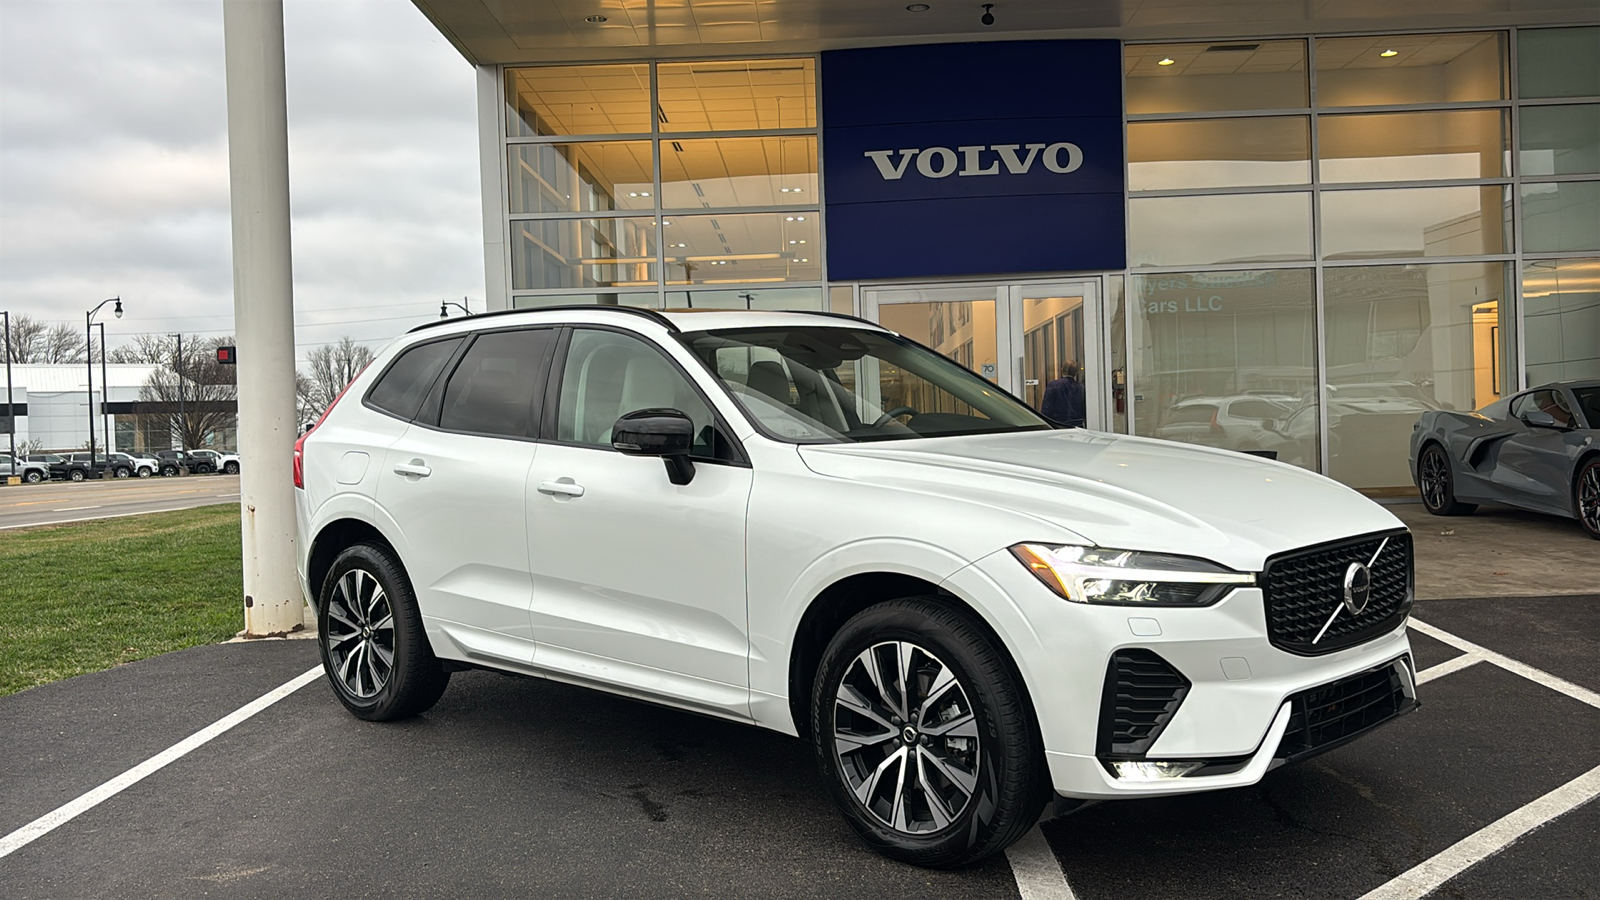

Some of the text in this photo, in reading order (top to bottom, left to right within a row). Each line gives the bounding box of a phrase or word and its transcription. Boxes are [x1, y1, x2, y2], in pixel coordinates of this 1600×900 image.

[864, 142, 1084, 180] VOLVO
[1184, 295, 1223, 312] LLC
[814, 663, 830, 759] SCORPION
